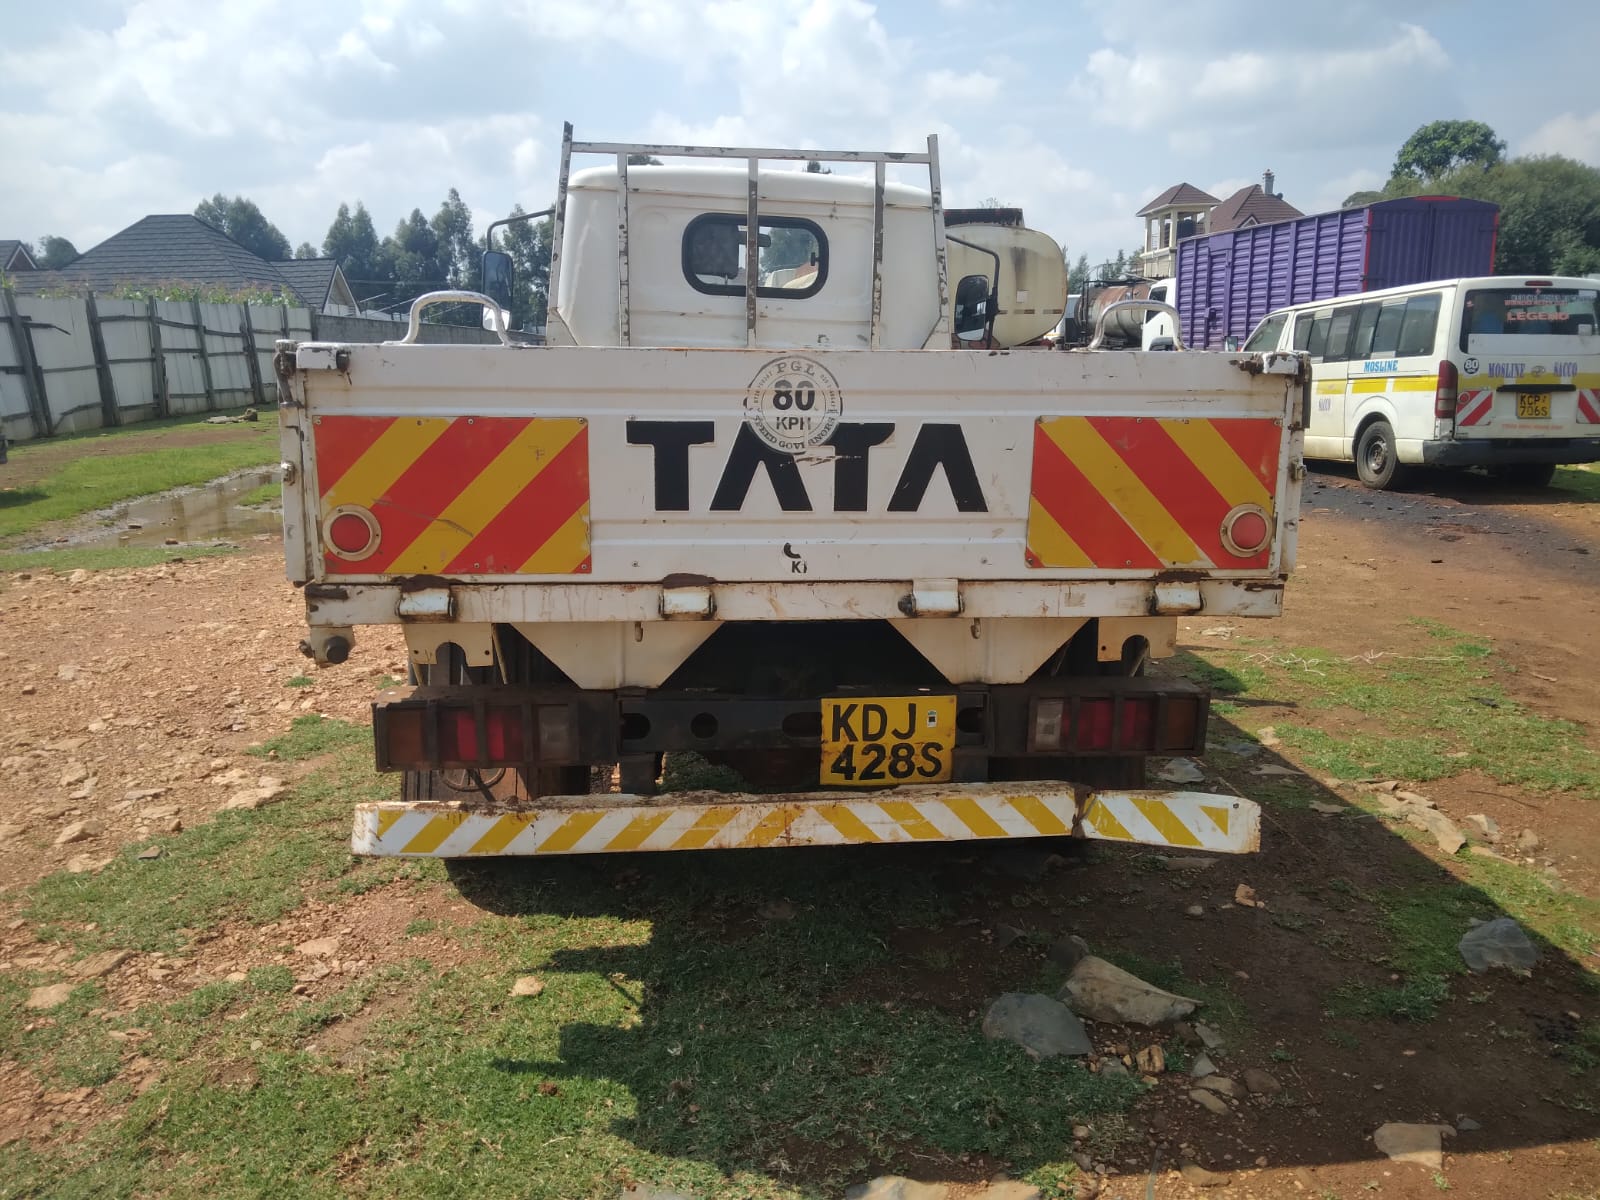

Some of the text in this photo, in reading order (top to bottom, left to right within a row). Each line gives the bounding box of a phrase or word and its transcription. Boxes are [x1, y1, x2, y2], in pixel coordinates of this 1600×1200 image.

[776, 360, 816, 377] PGL
[1364, 360, 1399, 373] MOSLINE
[1465, 359, 1480, 370] 80
[1488, 362, 1526, 379] MOSLINE
[772, 379, 816, 411] 80
[1520, 395, 1541, 406] KCP
[1520, 406, 1549, 417] 706S
[776, 416, 812, 431] KPH
[778, 416, 836, 450] GOVNORS
[626, 420, 990, 512] TATA
[831, 703, 917, 742] KDJ
[830, 742, 944, 781] 428S
